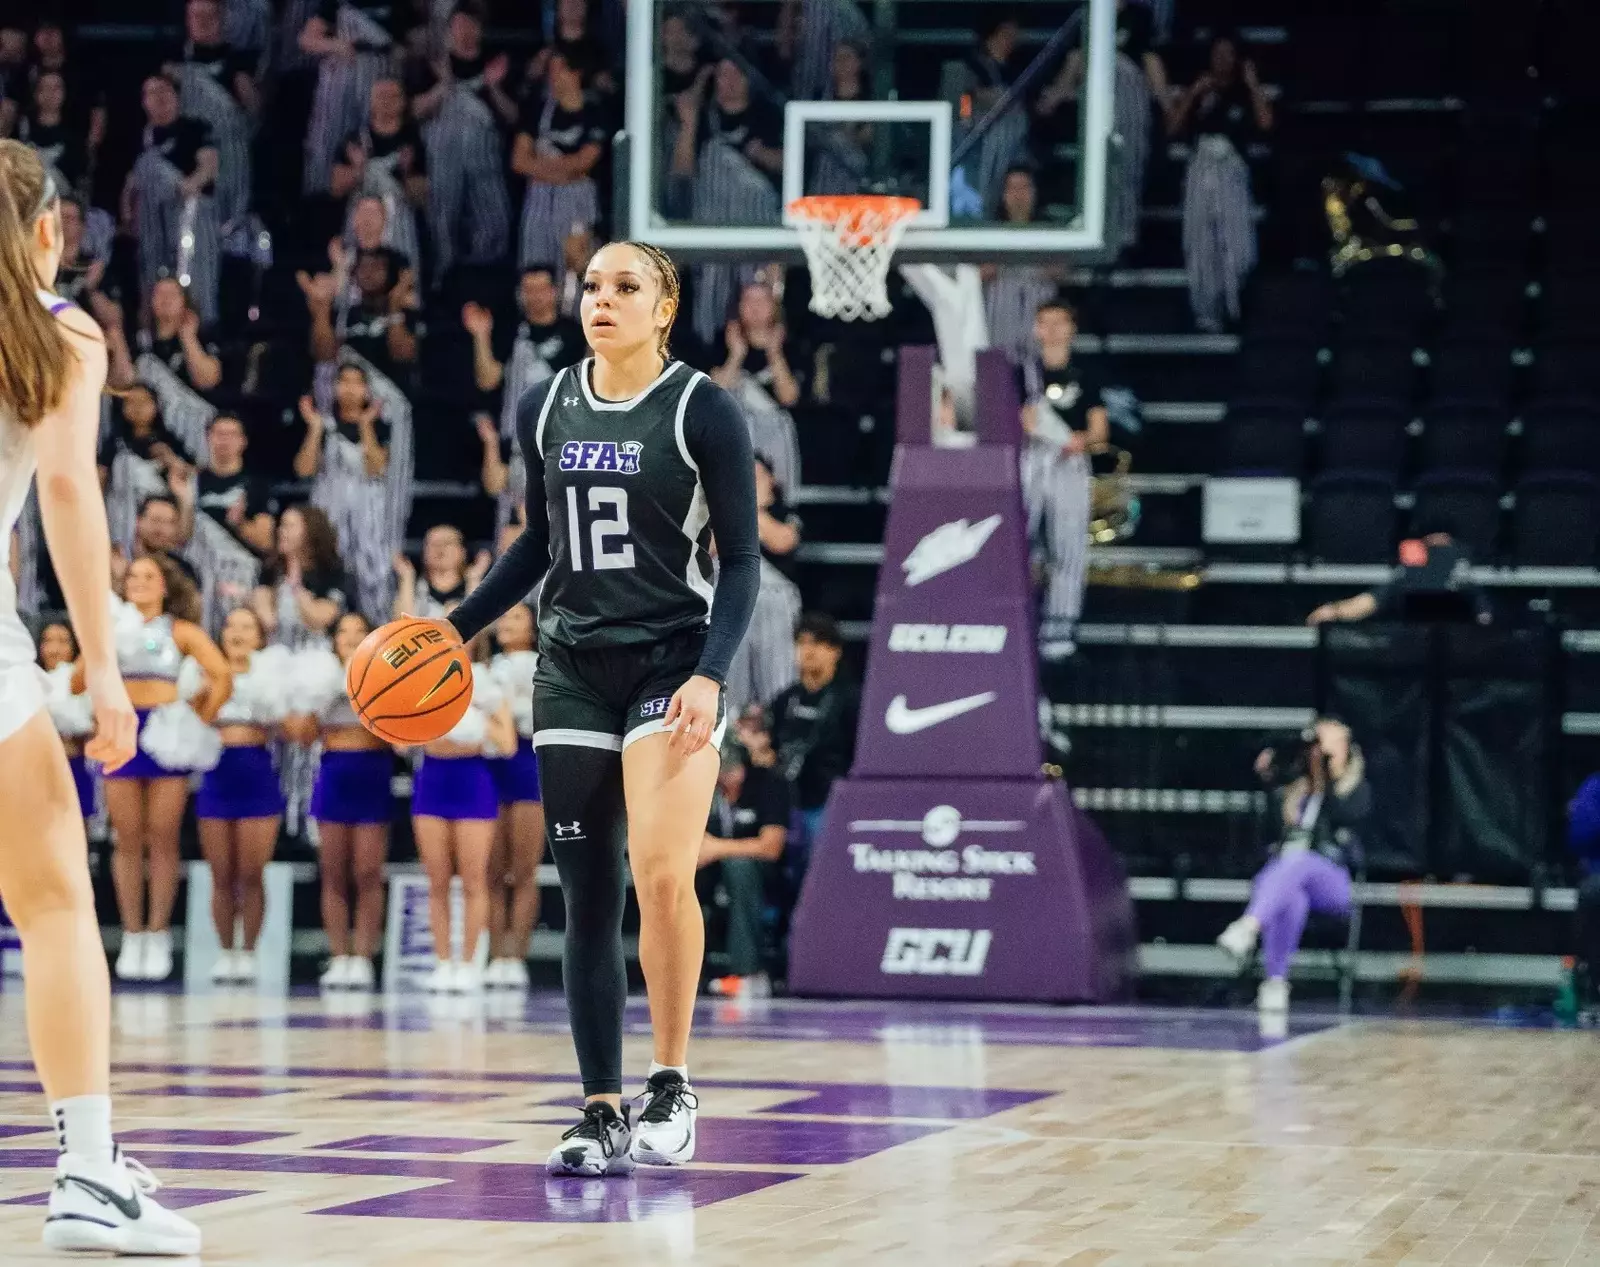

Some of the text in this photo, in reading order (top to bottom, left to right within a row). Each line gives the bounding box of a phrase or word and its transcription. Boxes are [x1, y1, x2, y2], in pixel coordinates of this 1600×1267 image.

[559, 441, 618, 472] SFA
[566, 486, 636, 572] 12
[382, 628, 447, 670] ELITE
[880, 927, 993, 976] GCU
